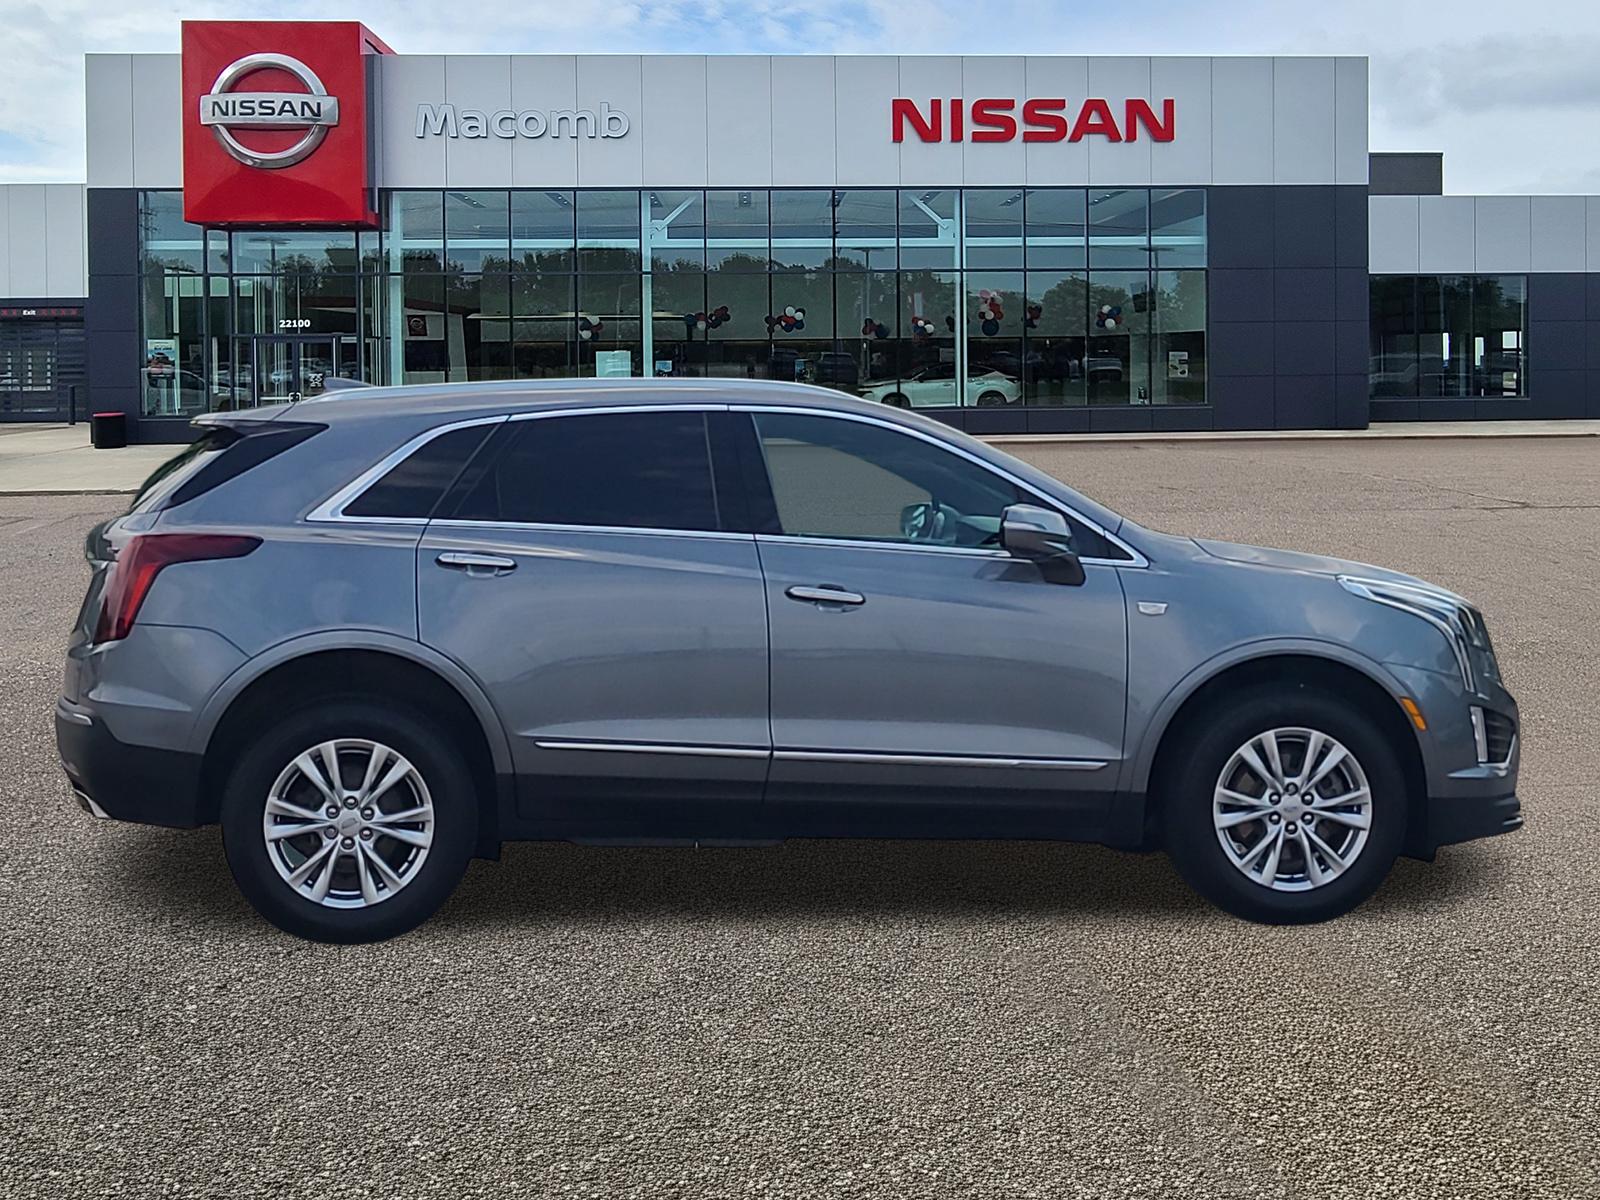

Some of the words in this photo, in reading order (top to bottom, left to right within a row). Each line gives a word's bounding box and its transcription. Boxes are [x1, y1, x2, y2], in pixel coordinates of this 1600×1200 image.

[212, 100, 322, 117] NISSAN
[415, 102, 630, 138] Macomb
[892, 98, 1175, 143] NISSAN
[279, 319, 311, 328] 22100
